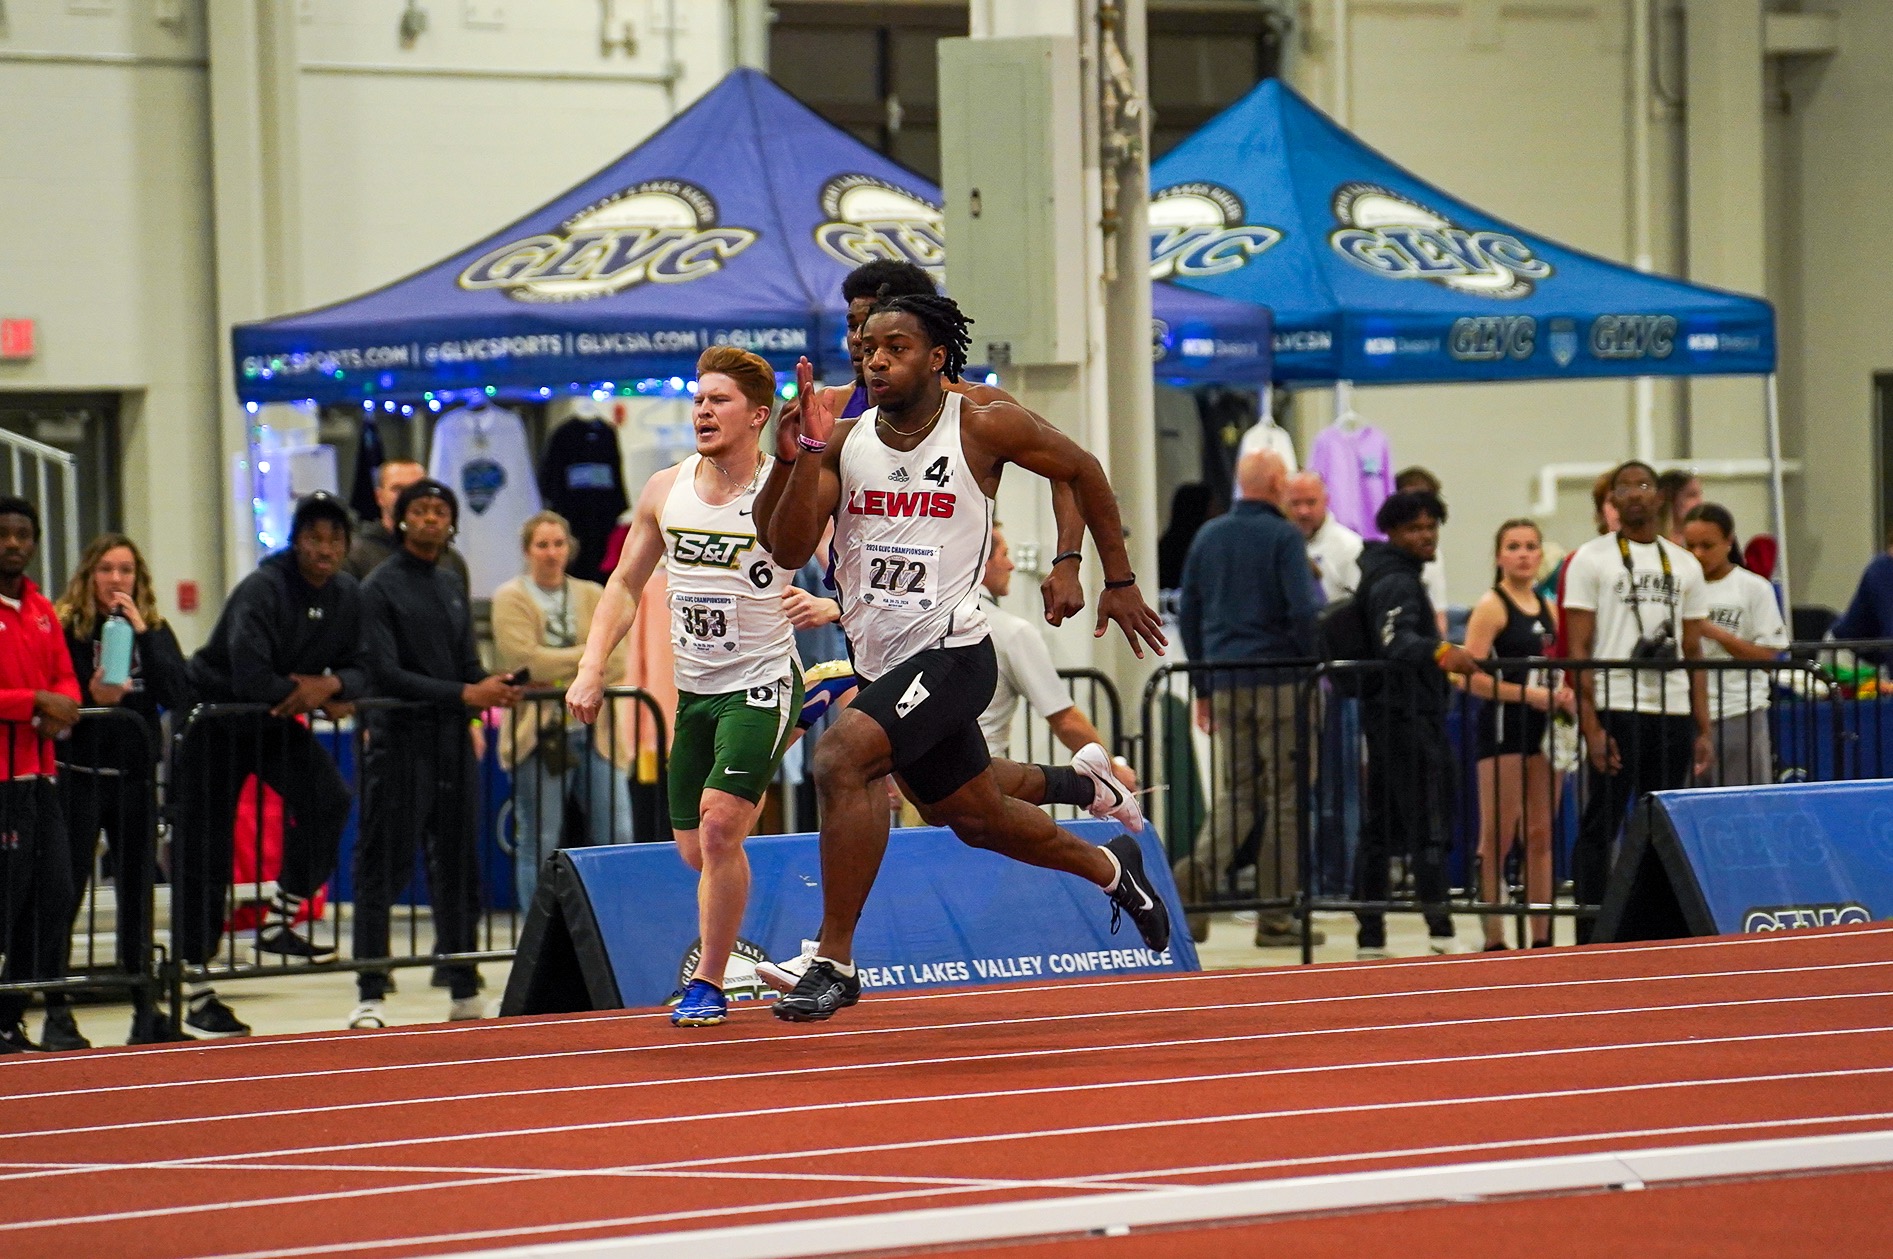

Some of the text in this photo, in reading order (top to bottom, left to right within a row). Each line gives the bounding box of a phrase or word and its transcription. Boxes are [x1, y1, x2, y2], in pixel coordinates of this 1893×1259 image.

[458, 228, 758, 290] GLVC
[1331, 228, 1550, 279] GLVC
[1451, 315, 1537, 361] GLVC
[1591, 314, 1678, 359] GLVC
[923, 456, 950, 487] 4
[848, 490, 957, 519] LEWIS
[672, 529, 753, 567] S&T
[866, 543, 878, 551] 2024
[891, 546, 934, 556] CHAMPIONSHIPS
[749, 560, 773, 588] 6
[870, 558, 926, 594] 272
[682, 606, 728, 638] 353
[857, 947, 1174, 988] REAT LAKES VALLEY CONFERENCE
